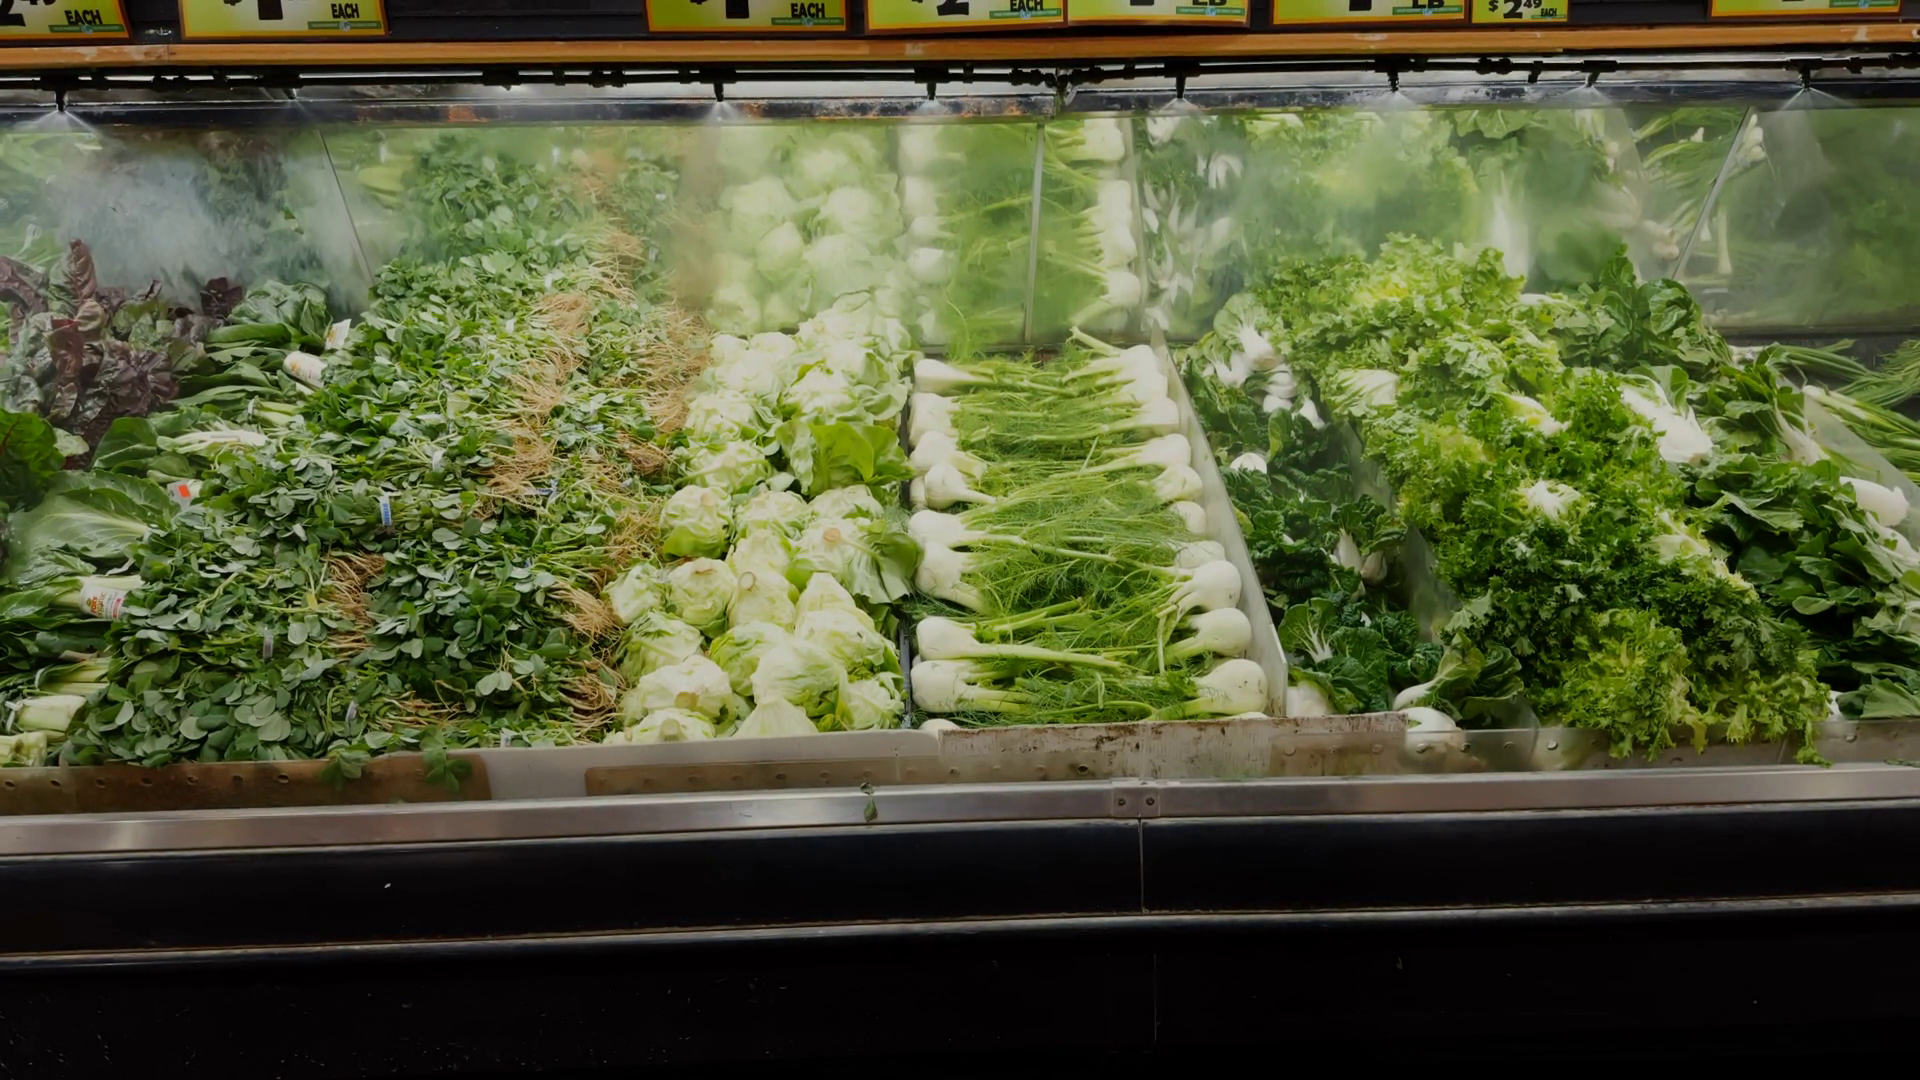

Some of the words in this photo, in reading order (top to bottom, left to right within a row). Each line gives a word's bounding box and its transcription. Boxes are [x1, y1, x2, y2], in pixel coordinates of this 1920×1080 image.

[331, 3, 360, 19] EACH
[791, 3, 826, 18] EACH
[1010, 0, 1044, 12] EACH
[1540, 8, 1558, 17] EACH
[64, 9, 104, 26] EACH
